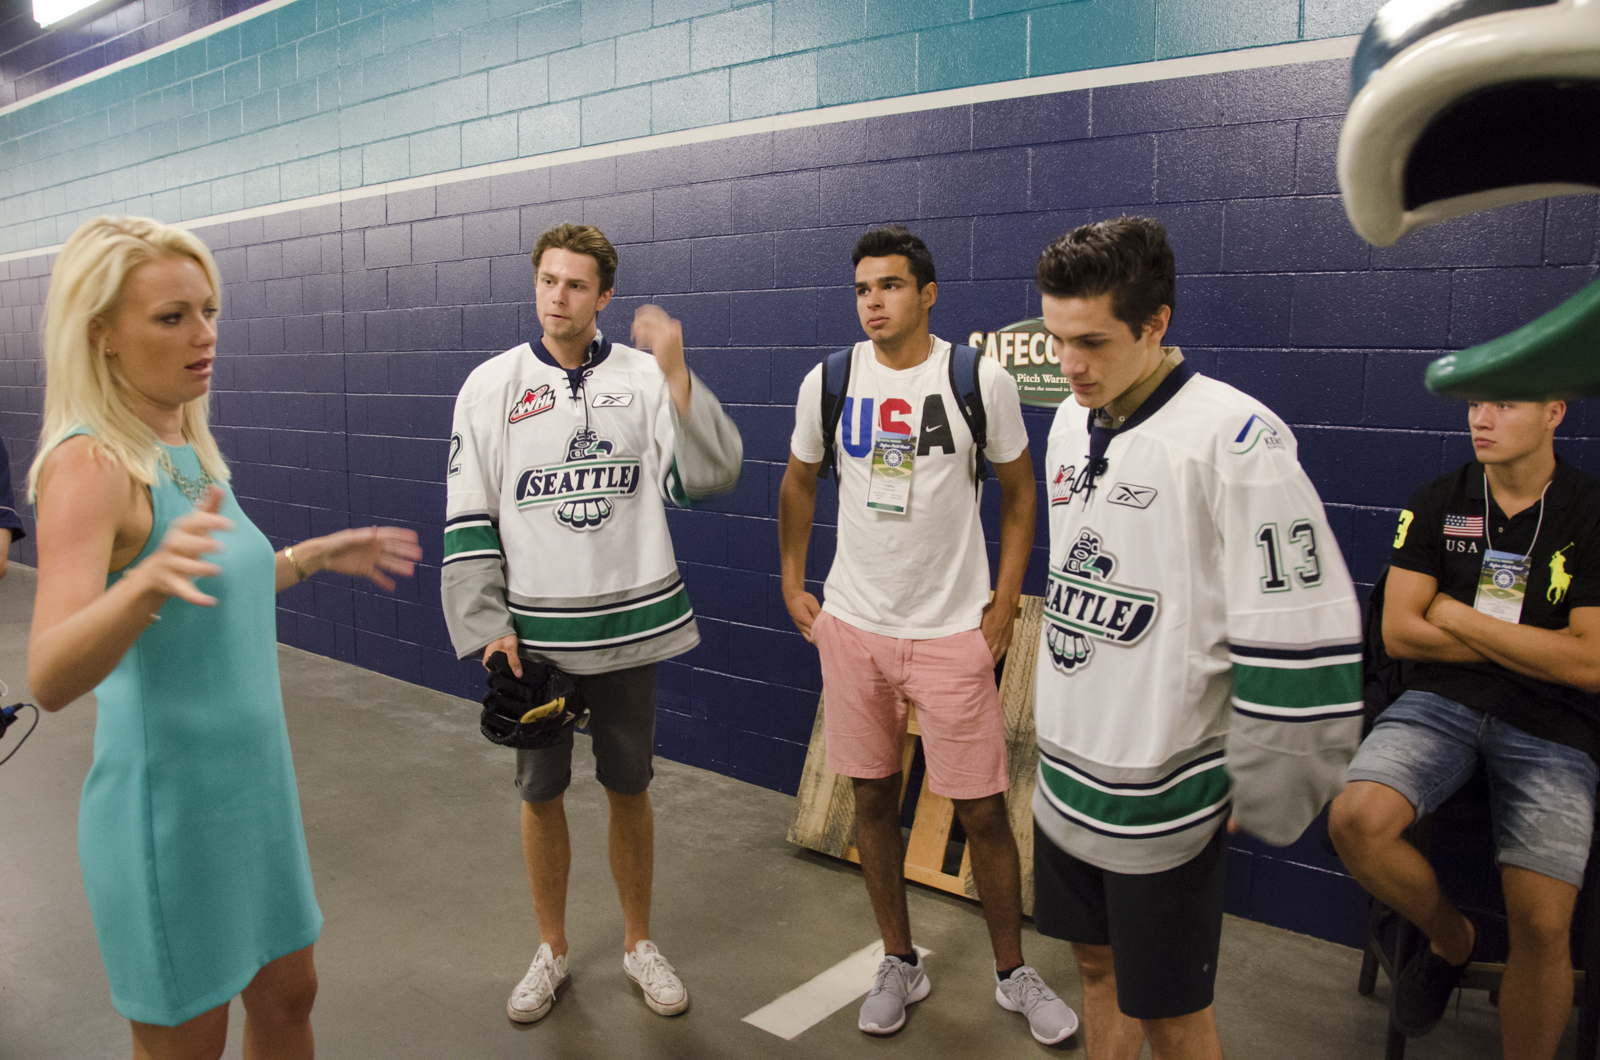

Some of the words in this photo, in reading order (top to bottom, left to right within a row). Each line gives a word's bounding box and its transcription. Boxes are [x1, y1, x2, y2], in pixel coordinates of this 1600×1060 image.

[1016, 373, 1041, 383] Pitch
[514, 390, 555, 416] WHL
[842, 393, 956, 459] USA
[526, 466, 631, 497] SEATTLE
[1392, 509, 1414, 549] 3
[1446, 539, 1478, 553] USA
[1255, 518, 1324, 594] 13
[1045, 579, 1133, 632] EATTLE
